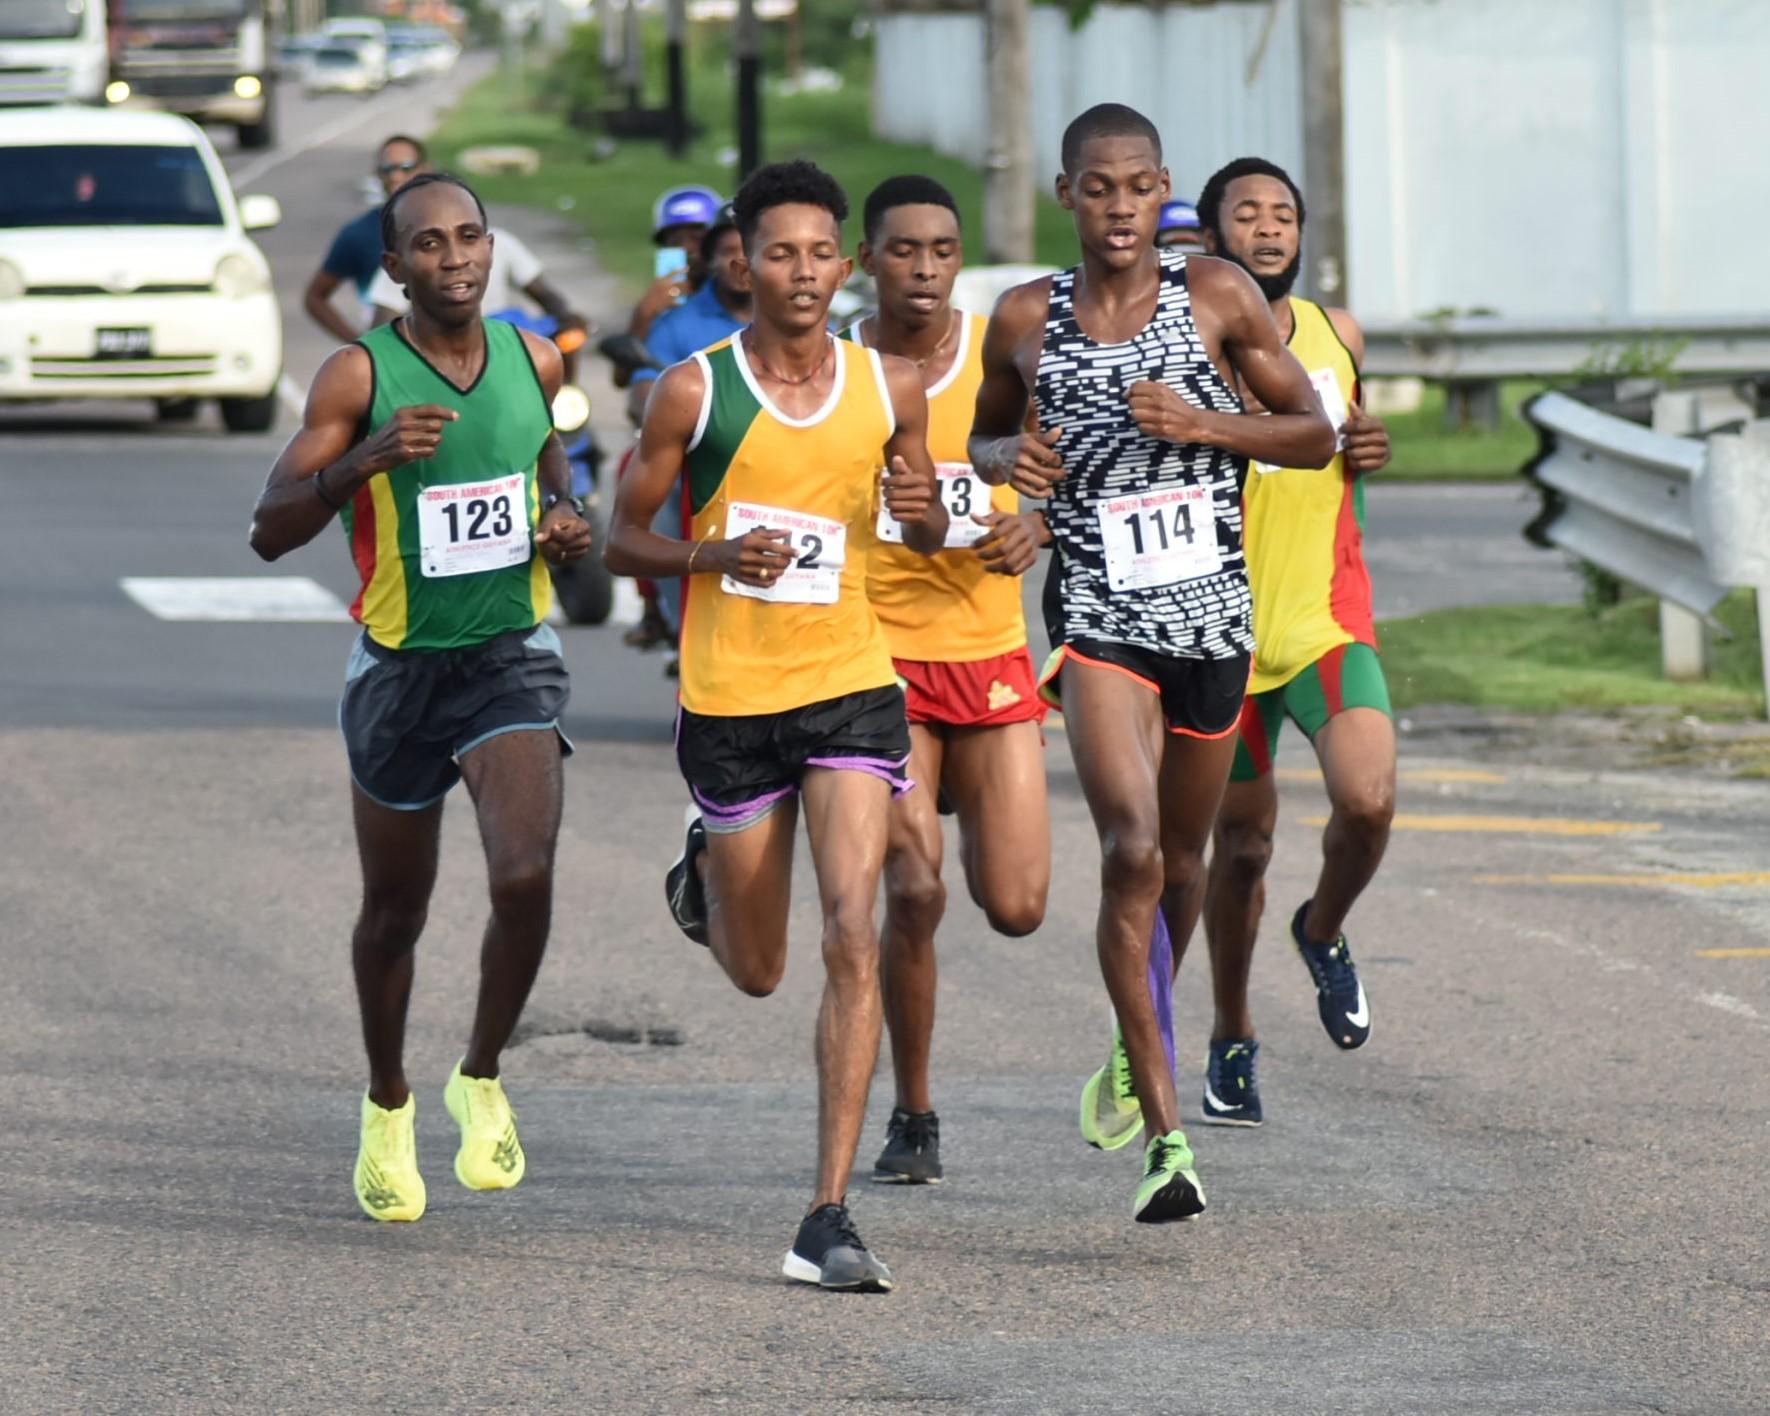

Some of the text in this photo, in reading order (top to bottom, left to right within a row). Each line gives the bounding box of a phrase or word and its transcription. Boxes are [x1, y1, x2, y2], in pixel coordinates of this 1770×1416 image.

[441, 494, 513, 543] 123
[737, 507, 769, 522] SOUTH
[1123, 503, 1195, 555] 114
